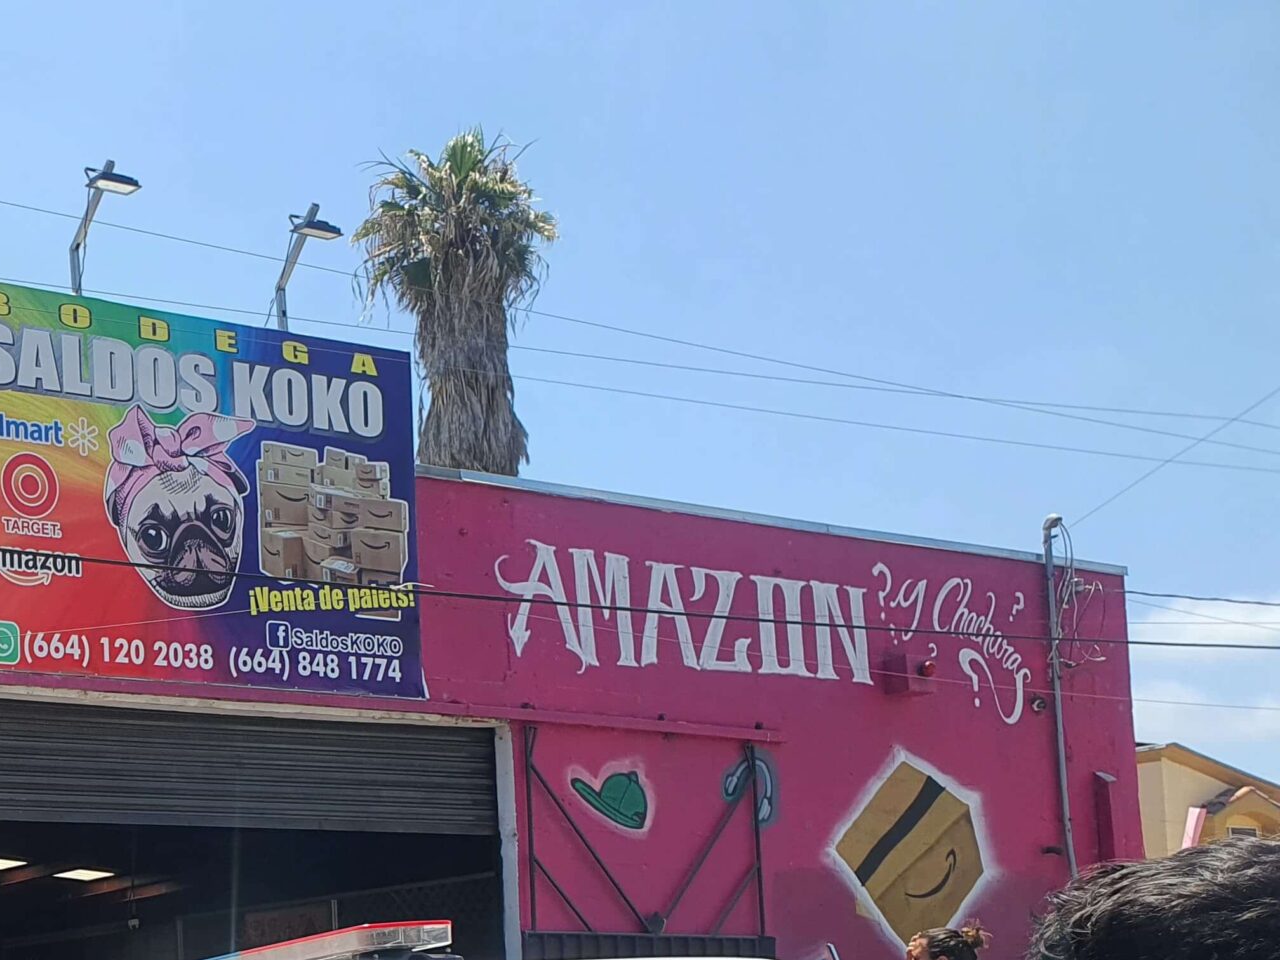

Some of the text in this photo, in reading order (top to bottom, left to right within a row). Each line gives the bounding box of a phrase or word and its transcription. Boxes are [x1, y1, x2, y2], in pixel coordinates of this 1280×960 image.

[232, 361, 384, 439] KOKO
[2, 516, 61, 538] TARGET
[249, 586, 316, 615] ¡Venta
[319, 585, 340, 610] de
[495, 539, 875, 685] AMAZON
[23, 631, 214, 669] (664) 120 2038
[291, 627, 404, 657] SaldosKOKO
[229, 646, 402, 682] (664) 848 1774
